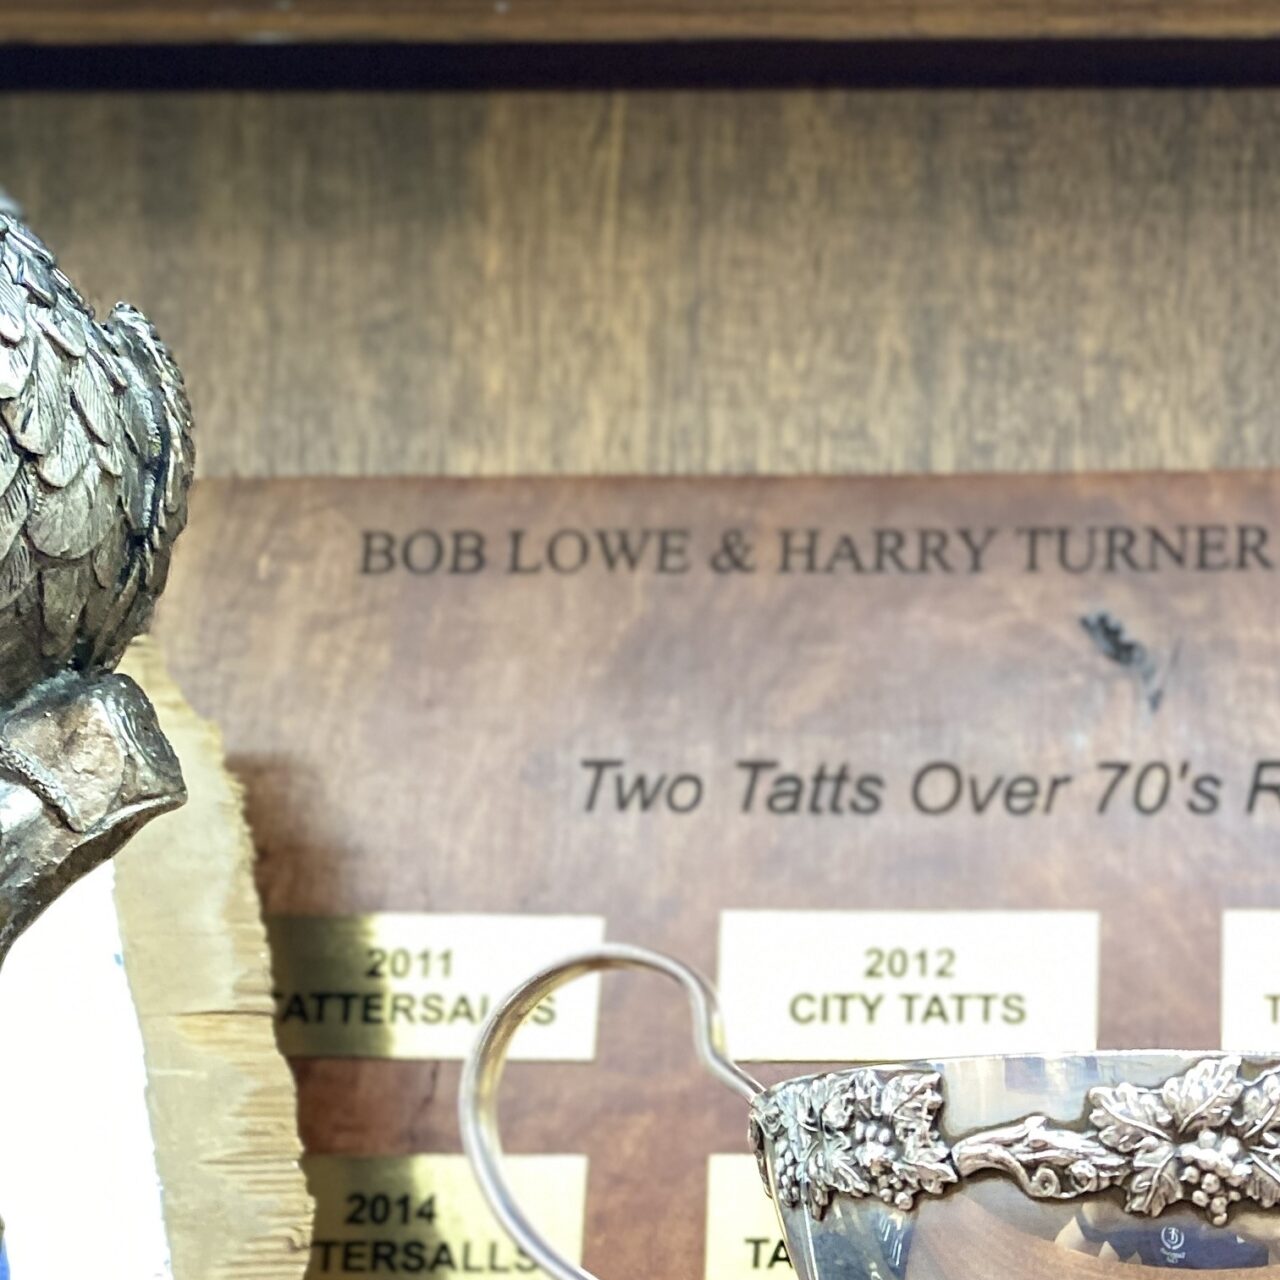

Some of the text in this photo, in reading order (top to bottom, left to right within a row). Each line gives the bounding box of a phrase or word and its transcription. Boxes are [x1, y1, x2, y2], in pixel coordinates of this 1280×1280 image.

[360, 530, 487, 576] BOB
[506, 528, 691, 575] LOWE
[709, 529, 755, 574] &
[778, 528, 997, 574] HARRY
[1017, 525, 1273, 574] TURNER
[581, 759, 703, 814] Two
[736, 761, 885, 815] Tatts
[911, 761, 1072, 816] Over
[1096, 762, 1221, 815] 70's
[366, 948, 454, 979] 2011
[864, 948, 956, 980] 2012
[272, 992, 557, 1027] ATTERSALS
[789, 993, 1027, 1026] CITY TATTS
[344, 1193, 437, 1226] 2014
